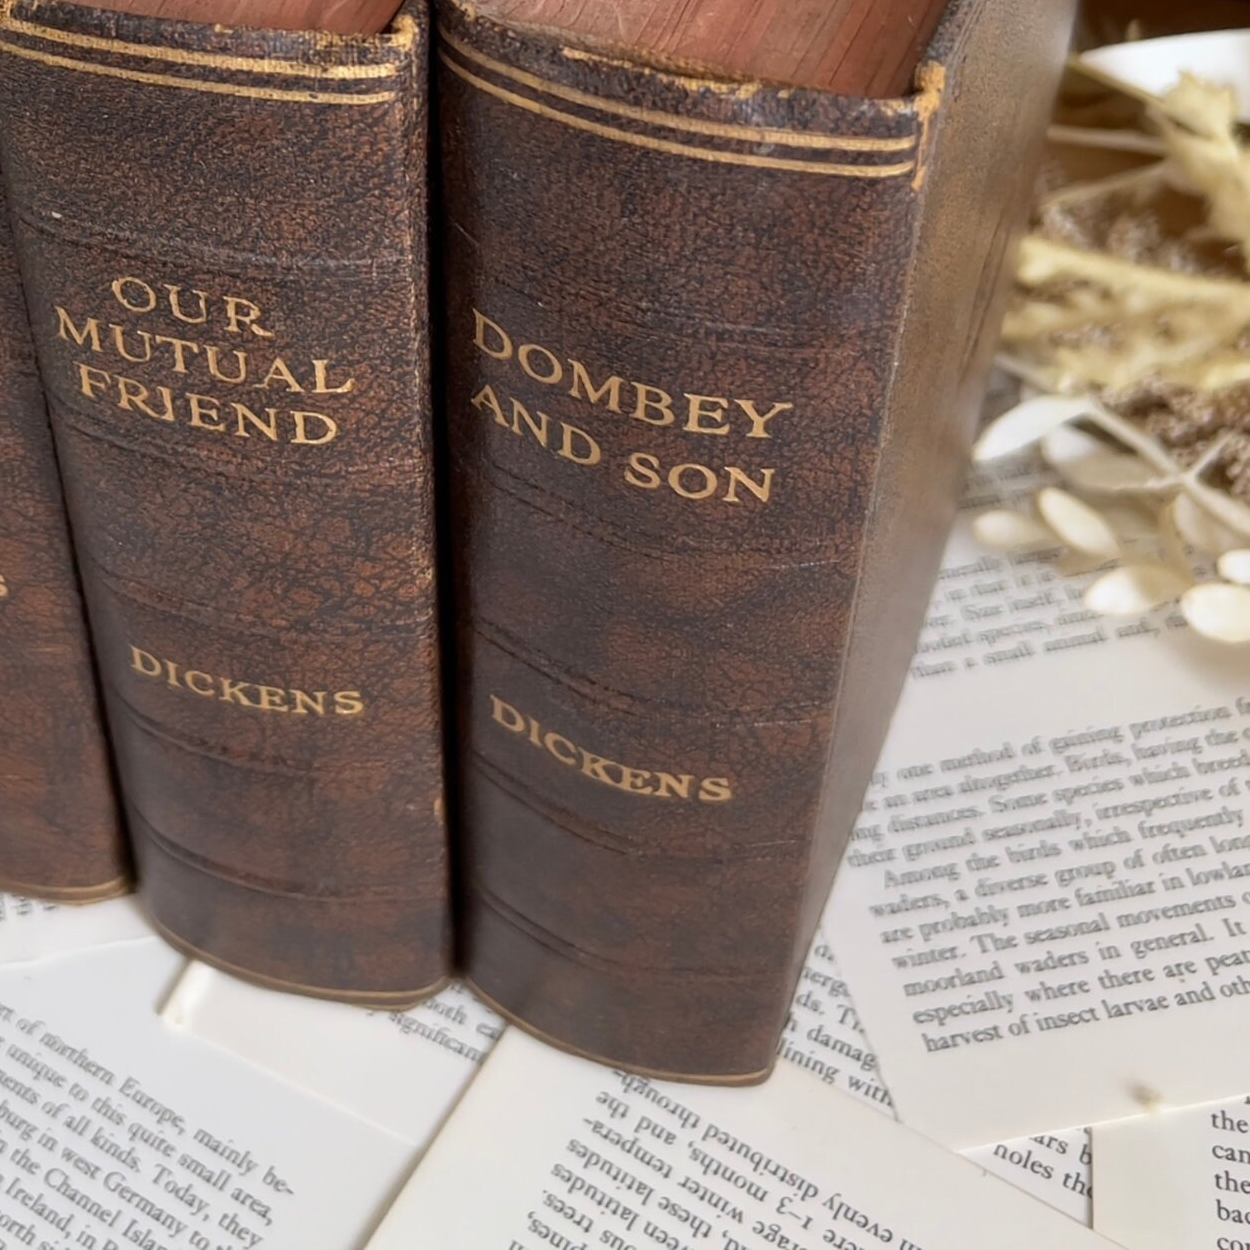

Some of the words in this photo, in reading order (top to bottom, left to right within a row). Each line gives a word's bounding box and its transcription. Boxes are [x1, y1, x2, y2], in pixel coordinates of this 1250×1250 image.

[111, 275, 275, 338] OUR
[54, 304, 355, 394] MUTUAL
[472, 307, 793, 439] DOMBEY
[73, 360, 339, 447] FRIEND
[471, 383, 601, 466] AND
[623, 452, 776, 504] SON
[129, 645, 366, 716] DICKENS
[489, 694, 734, 803] DICKENS
[975, 875, 1048, 897] diverse
[1055, 861, 1116, 887] group
[1123, 849, 1145, 869] of
[1152, 844, 1207, 864] often
[1069, 827, 1132, 850] which
[881, 928, 913, 943] are
[919, 905, 1008, 942] probably
[1017, 898, 1071, 918] more
[1075, 877, 1156, 907] familiar
[1159, 871, 1187, 891] in
[892, 947, 966, 968] winter.
[970, 933, 1018, 953] The
[1024, 913, 1110, 945] seasonal
[1116, 895, 1236, 928] movements
[903, 961, 1005, 996] moorland
[1014, 951, 1089, 974] waders
[1096, 942, 1121, 960] in
[1130, 923, 1214, 959] general.
[1222, 918, 1246, 937] It
[913, 991, 1013, 1026] especially
[1024, 981, 1090, 1002] where
[1098, 969, 1155, 989] there
[1163, 961, 1197, 978] are
[922, 1025, 1003, 1052] harvest
[1008, 1014, 1030, 1036] of
[1033, 1008, 1100, 1031] insect
[1101, 996, 1169, 1019] larvae
[1174, 981, 1216, 1006] and
[8, 1045, 66, 1087] unique
[69, 1083, 88, 1101] to
[91, 1097, 126, 1126] this
[128, 1123, 175, 1157] quite
[178, 1154, 231, 1191] small
[231, 1188, 272, 1226] area,
[17, 1019, 43, 1035] of
[40, 1033, 114, 1085] northern
[119, 1077, 185, 1135] Europe,
[193, 1129, 258, 1176] mainly
[263, 1166, 293, 1194] be-
[596, 1092, 629, 1119] the
[634, 1116, 677, 1145] and
[1211, 1110, 1249, 1133] the
[42, 1102, 68, 1118] of
[64, 1116, 91, 1136] all
[152, 1164, 209, 1221] Today,
[218, 1213, 263, 1250] they
[567, 1139, 655, 1206] latitudes
[584, 1119, 673, 1179] tempera-
[688, 1141, 768, 1202] months,
[693, 1124, 819, 1202] distributed
[10, 1149, 40, 1175] the
[44, 1168, 122, 1227] Channel
[38, 1129, 57, 1151] in
[61, 1148, 101, 1179] west
[104, 1172, 191, 1238] Germany
[189, 1231, 210, 1250] to
[543, 1190, 594, 1233] trees.
[551, 1164, 645, 1231] latitudes
[658, 1197, 712, 1238] these
[677, 1176, 743, 1224] winter
[822, 1193, 893, 1243] evenly
